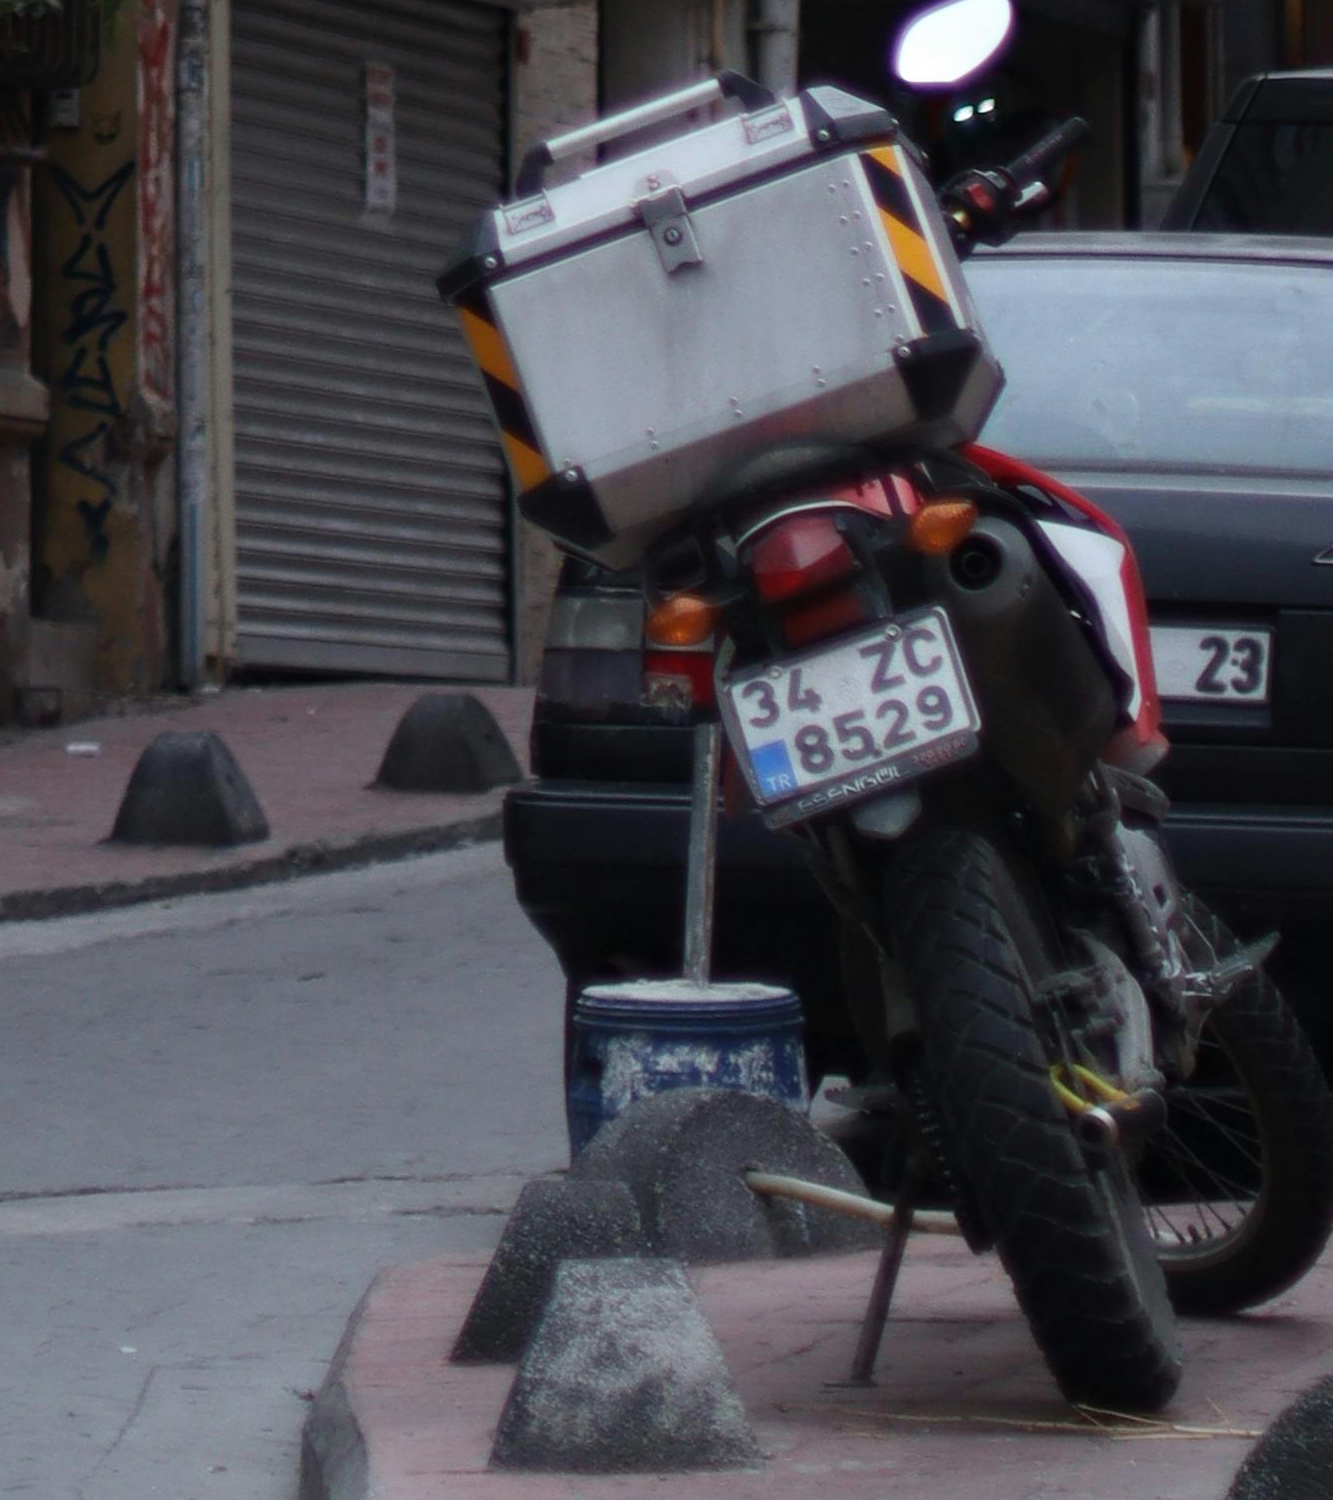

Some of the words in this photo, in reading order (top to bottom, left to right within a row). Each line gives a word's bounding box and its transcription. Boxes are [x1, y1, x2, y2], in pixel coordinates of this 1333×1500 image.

[742, 668, 823, 728] 34
[859, 629, 943, 694] ZC
[1195, 636, 1263, 694] 23
[795, 685, 953, 774] 8529
[766, 773, 793, 794] TR
